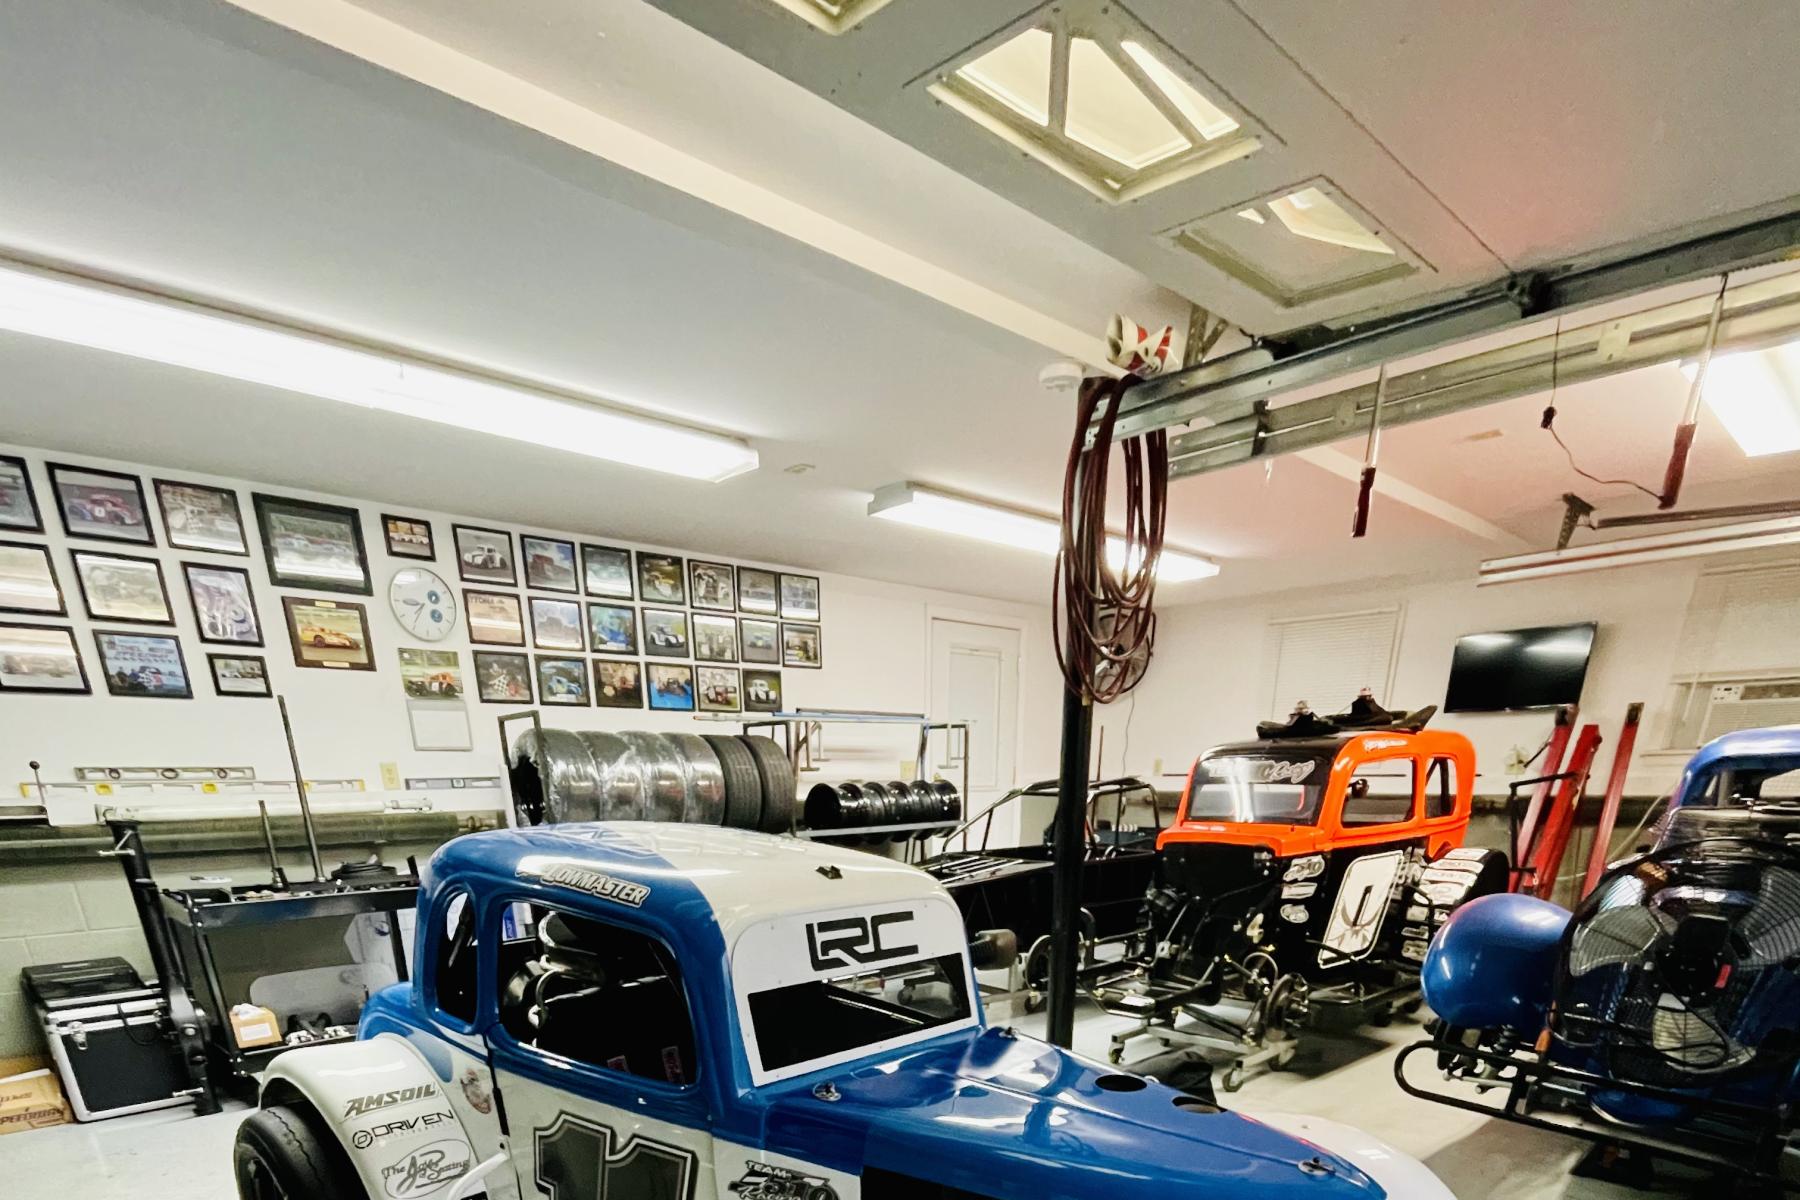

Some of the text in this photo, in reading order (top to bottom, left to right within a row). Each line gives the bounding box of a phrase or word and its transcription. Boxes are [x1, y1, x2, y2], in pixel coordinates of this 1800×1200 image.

[516, 862, 651, 907] LOWMASTER
[805, 911, 919, 972] LRC
[344, 1084, 437, 1118] AMSOIL
[371, 1109, 454, 1138] DRIVEN
[745, 1161, 787, 1178] TEAM
